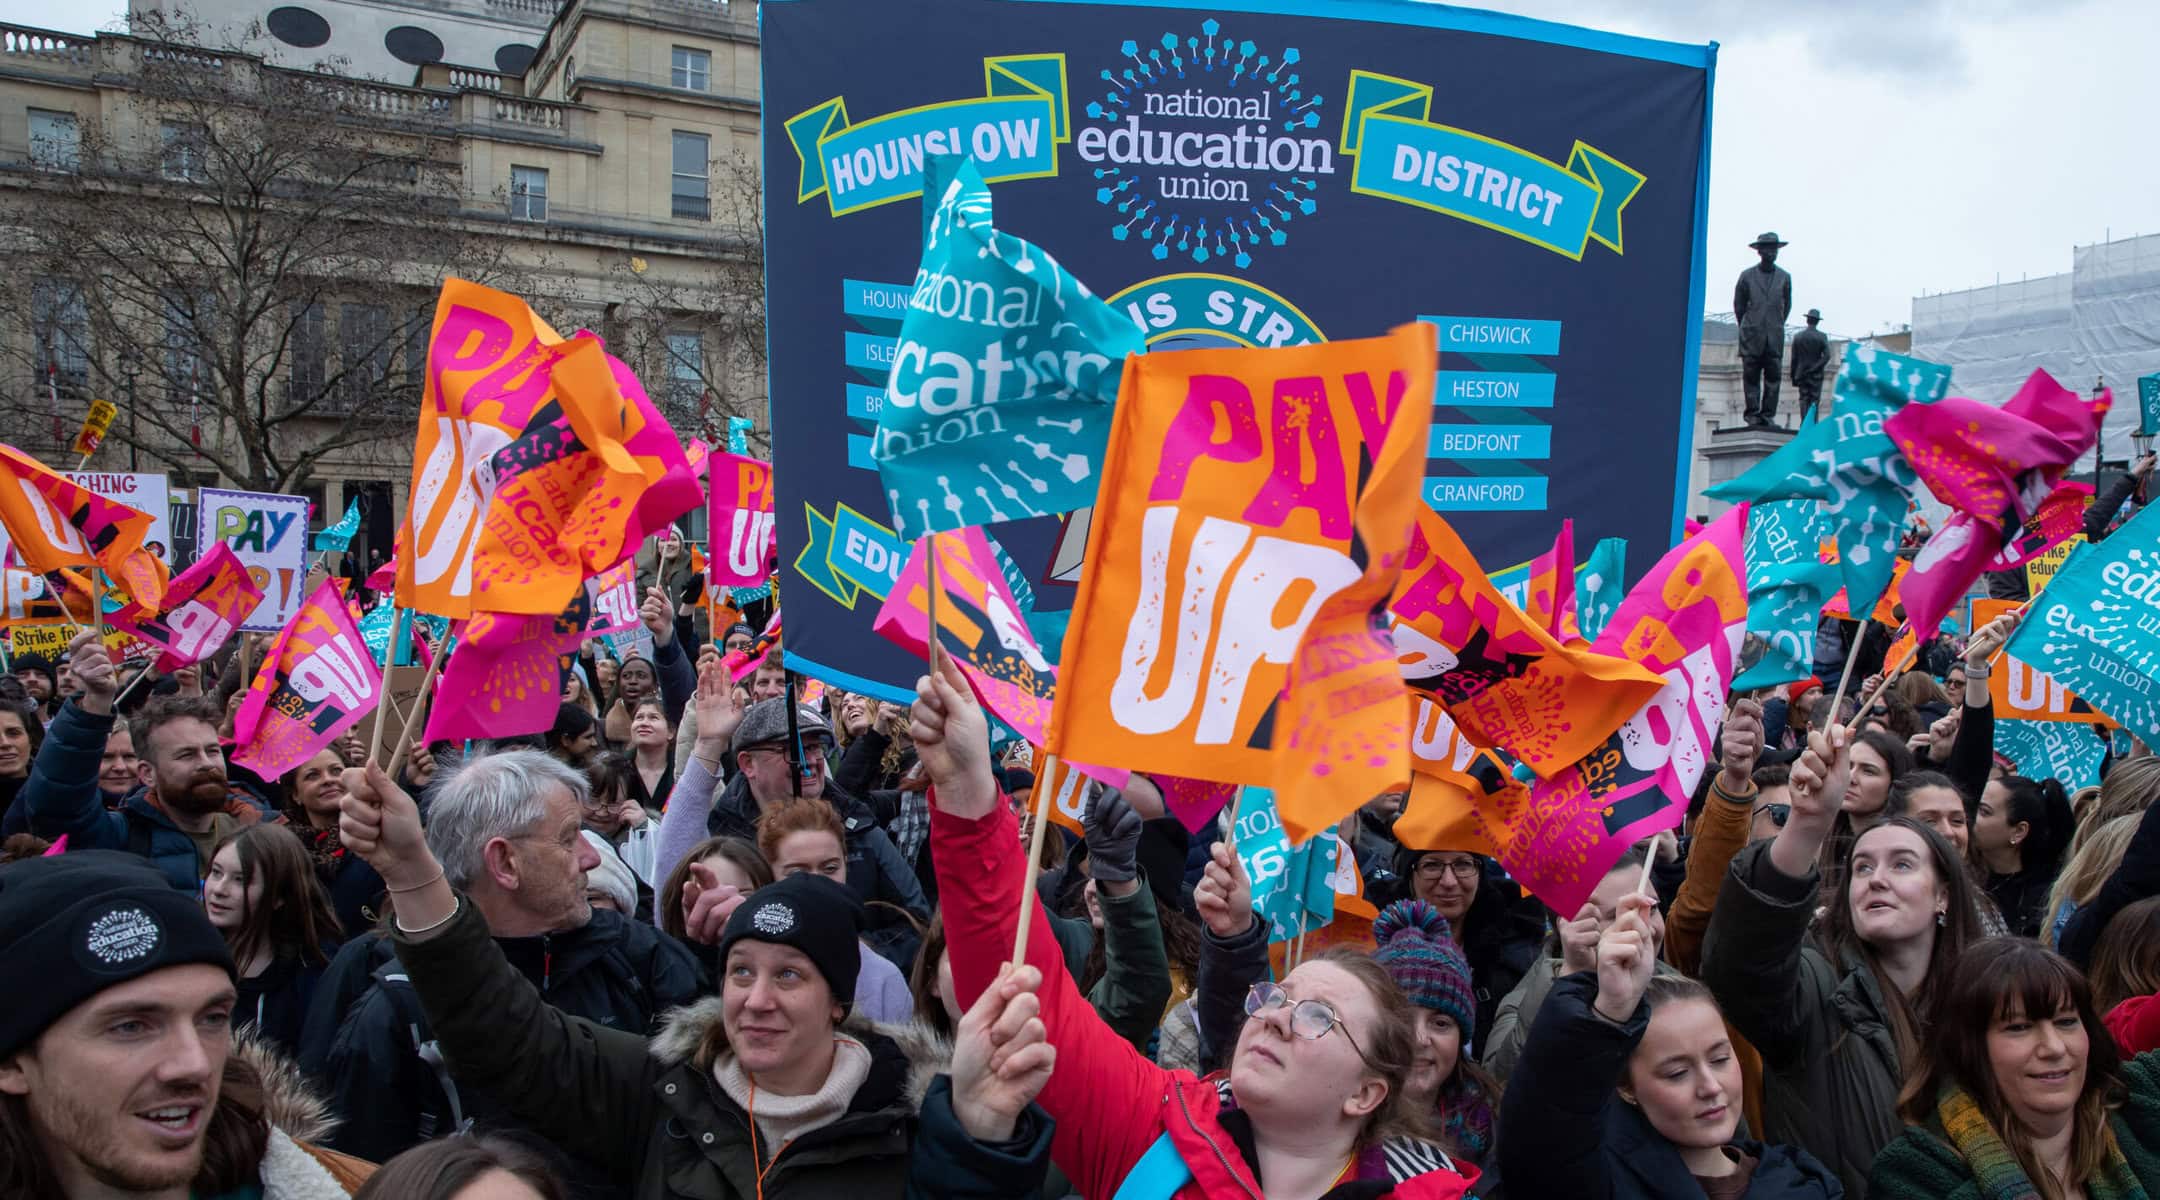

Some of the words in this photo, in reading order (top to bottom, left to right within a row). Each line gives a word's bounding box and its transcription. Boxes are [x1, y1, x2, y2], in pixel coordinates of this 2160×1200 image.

[1144, 88, 1271, 121] national
[1077, 115, 1335, 174] education
[1158, 173, 1250, 203] union
[1392, 143, 1563, 227] DISTRICT
[1449, 324, 1532, 344] CHISWICK
[1453, 380, 1519, 398] HESTON
[1443, 433, 1521, 451] BEDFONT
[1432, 484, 1525, 502] CRANFORD
[215, 505, 297, 553] PAY
[15, 628, 57, 646] Strike
[2088, 651, 2152, 696] union
[88, 924, 159, 951] education
